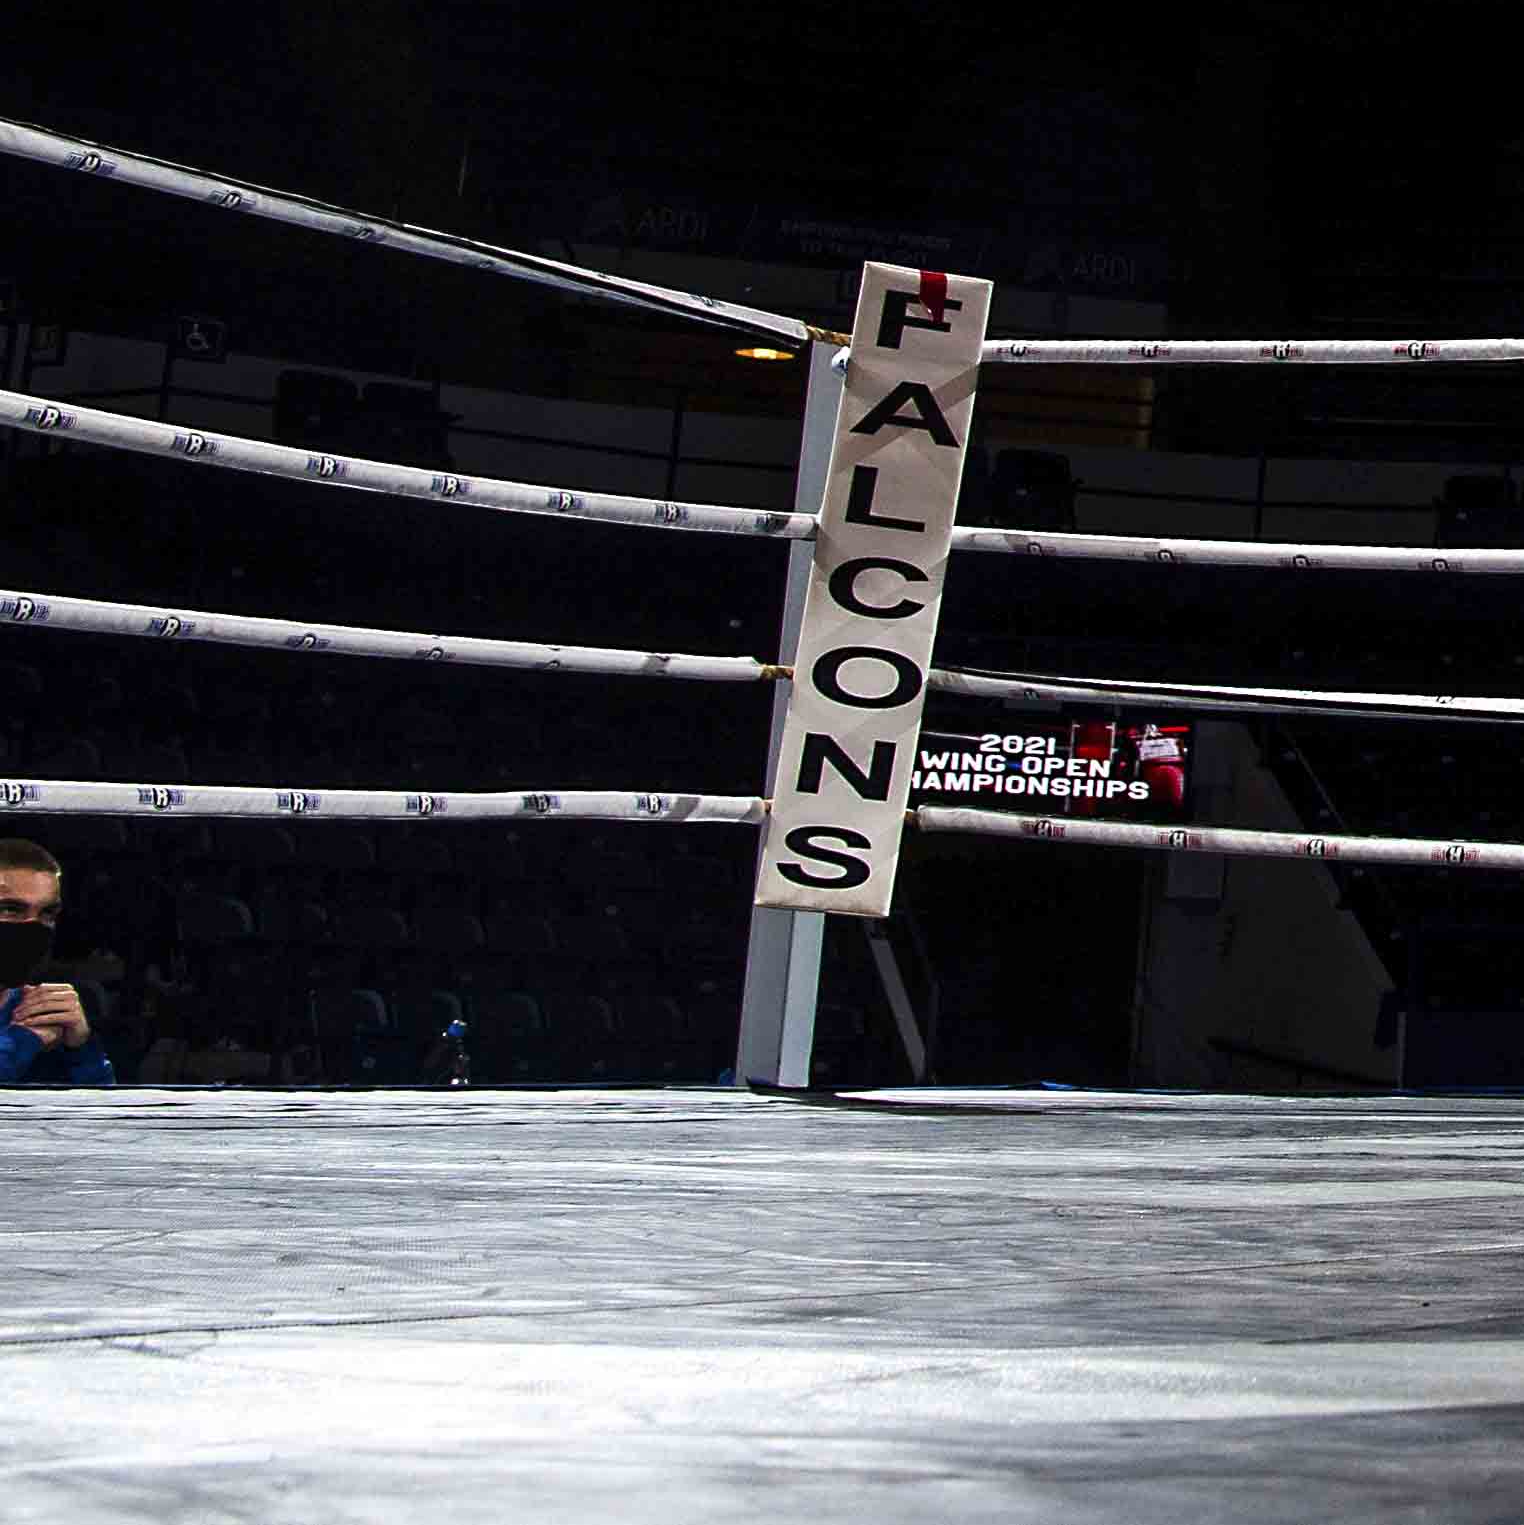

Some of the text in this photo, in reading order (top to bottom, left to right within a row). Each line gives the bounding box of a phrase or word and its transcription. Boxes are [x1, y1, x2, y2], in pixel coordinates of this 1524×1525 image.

[775, 290, 962, 890] FALCONS
[979, 733, 1056, 755] 2021
[920, 750, 1111, 778] WING OPEN
[910, 770, 1150, 800] HAMPIONSHIPS
